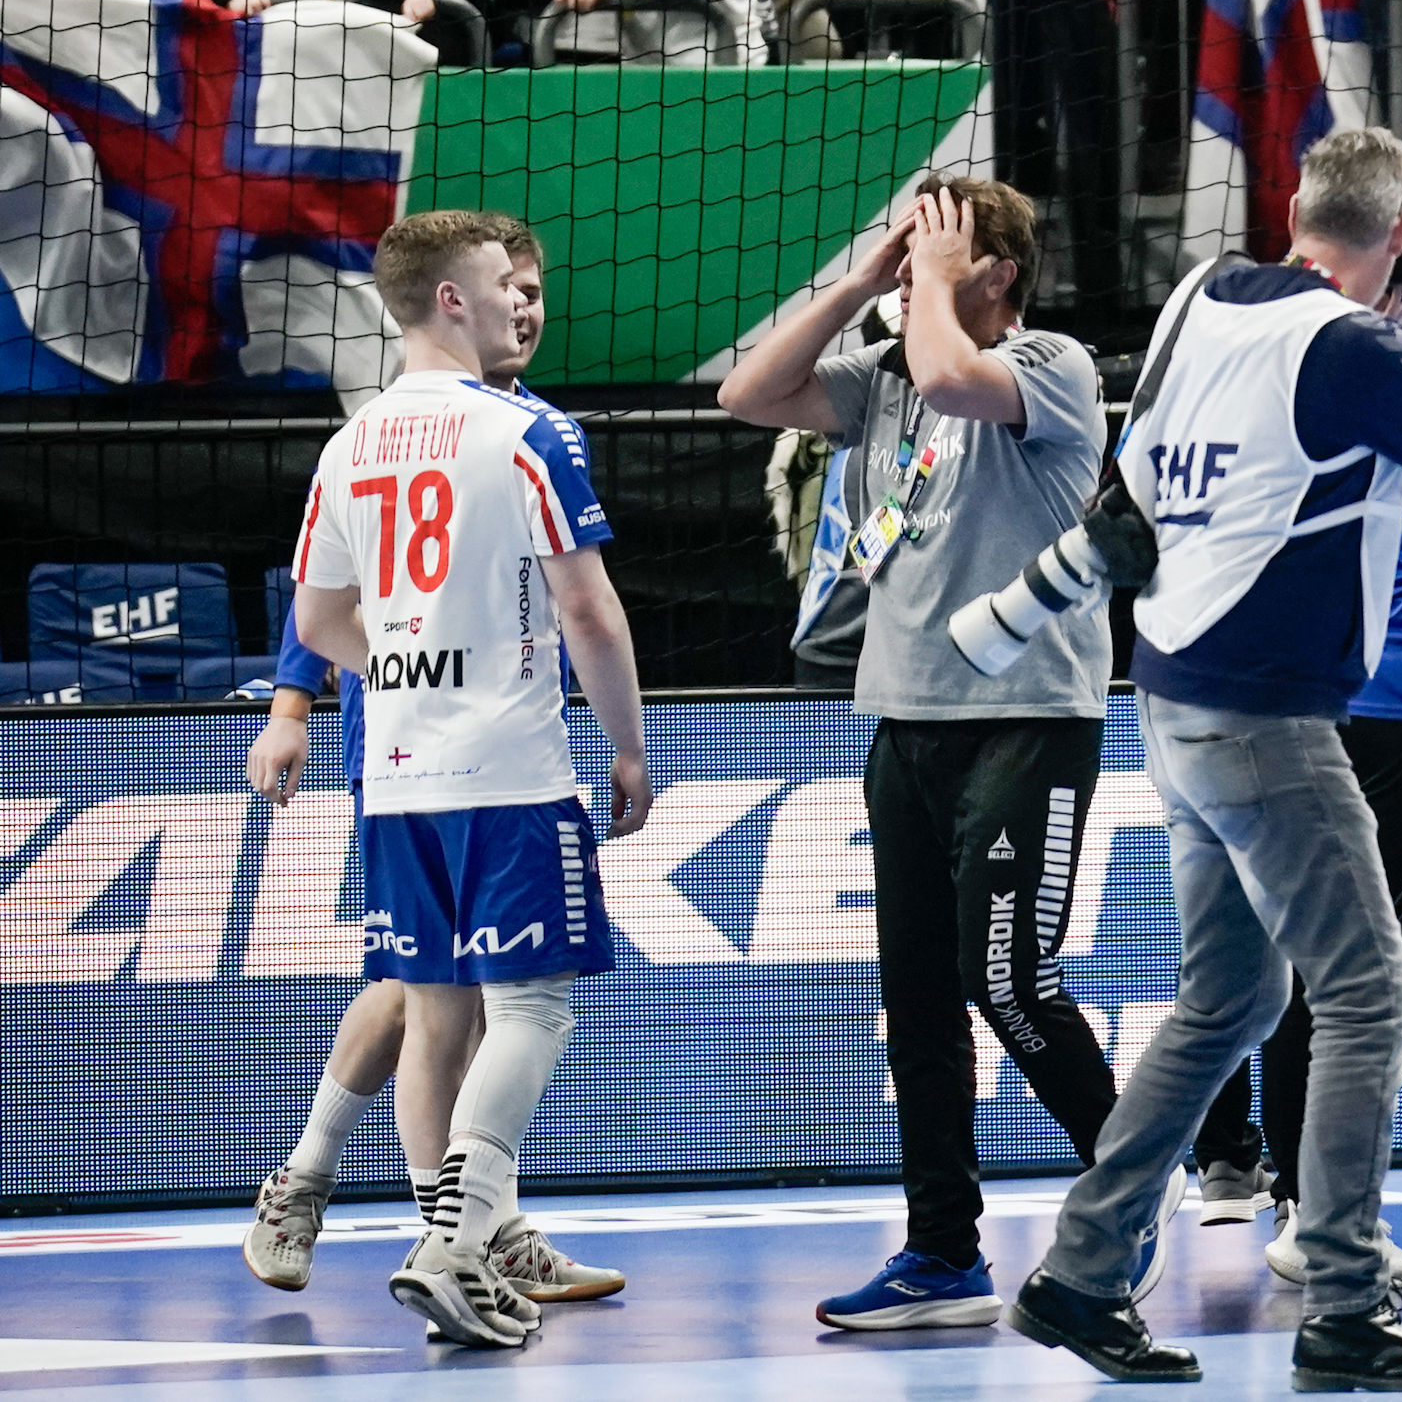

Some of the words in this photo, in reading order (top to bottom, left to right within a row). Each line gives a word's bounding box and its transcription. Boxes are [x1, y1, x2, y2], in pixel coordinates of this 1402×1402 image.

[376, 403, 466, 465] MITTÚN
[350, 469, 453, 599] 78
[91, 587, 179, 639] EHF
[364, 649, 464, 694] MOWI
[364, 931, 419, 957] ORG
[453, 921, 545, 960] KIA
